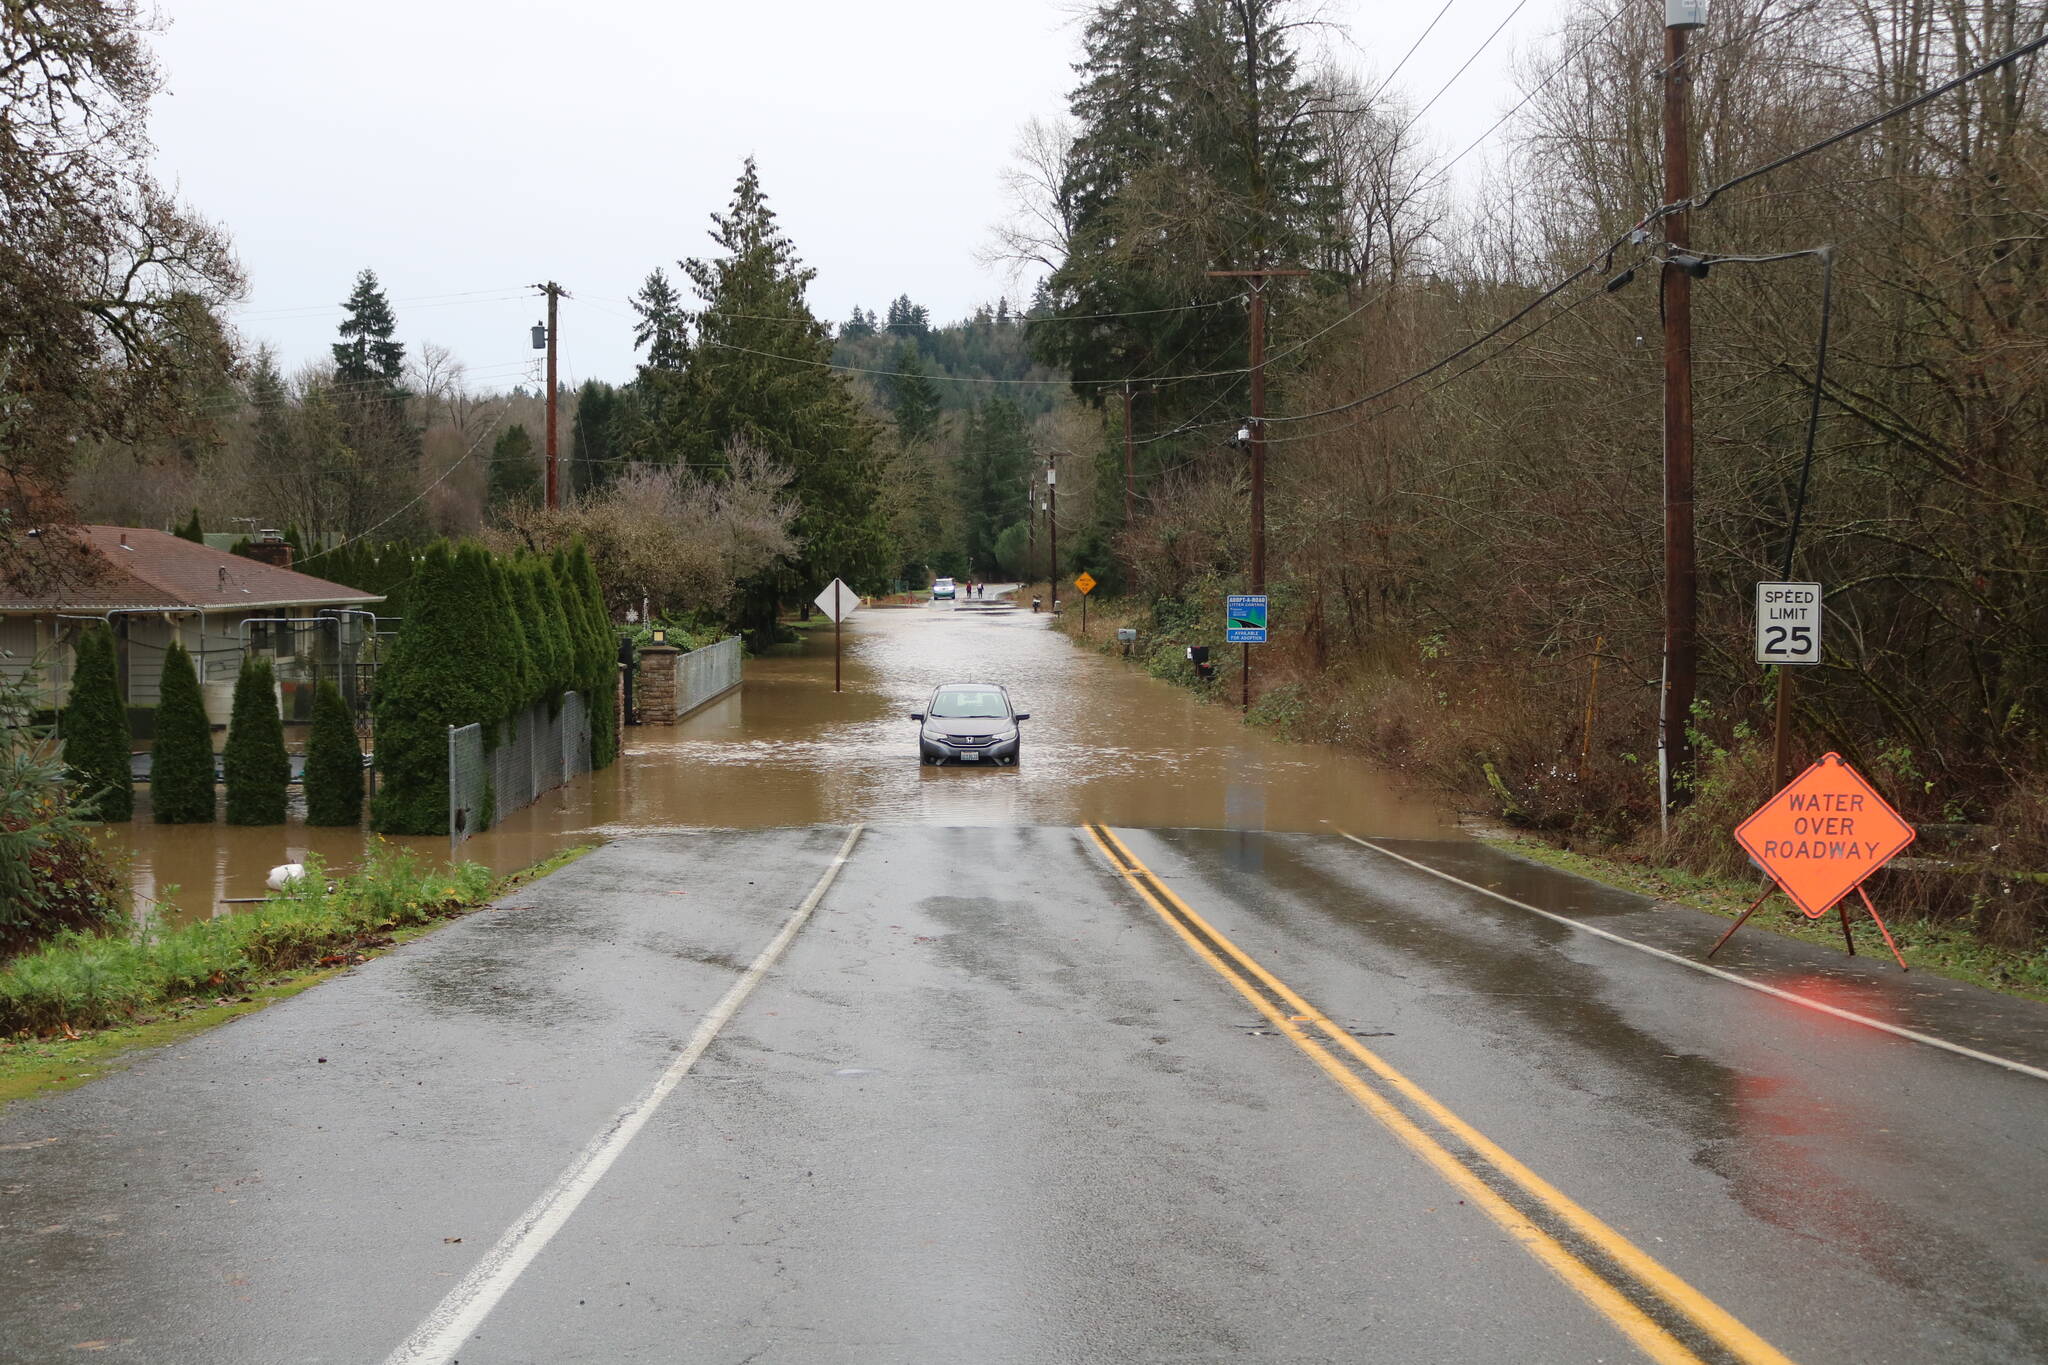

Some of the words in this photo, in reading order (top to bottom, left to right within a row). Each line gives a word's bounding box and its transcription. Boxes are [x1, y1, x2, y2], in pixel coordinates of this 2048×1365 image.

[1765, 591, 1814, 603] SPEED
[1770, 608, 1808, 620] LIMIT
[1765, 626, 1812, 655] 25
[1789, 794, 1865, 812] WATER
[1794, 817, 1855, 835] OVER
[1764, 841, 1880, 859] ROADWAY
